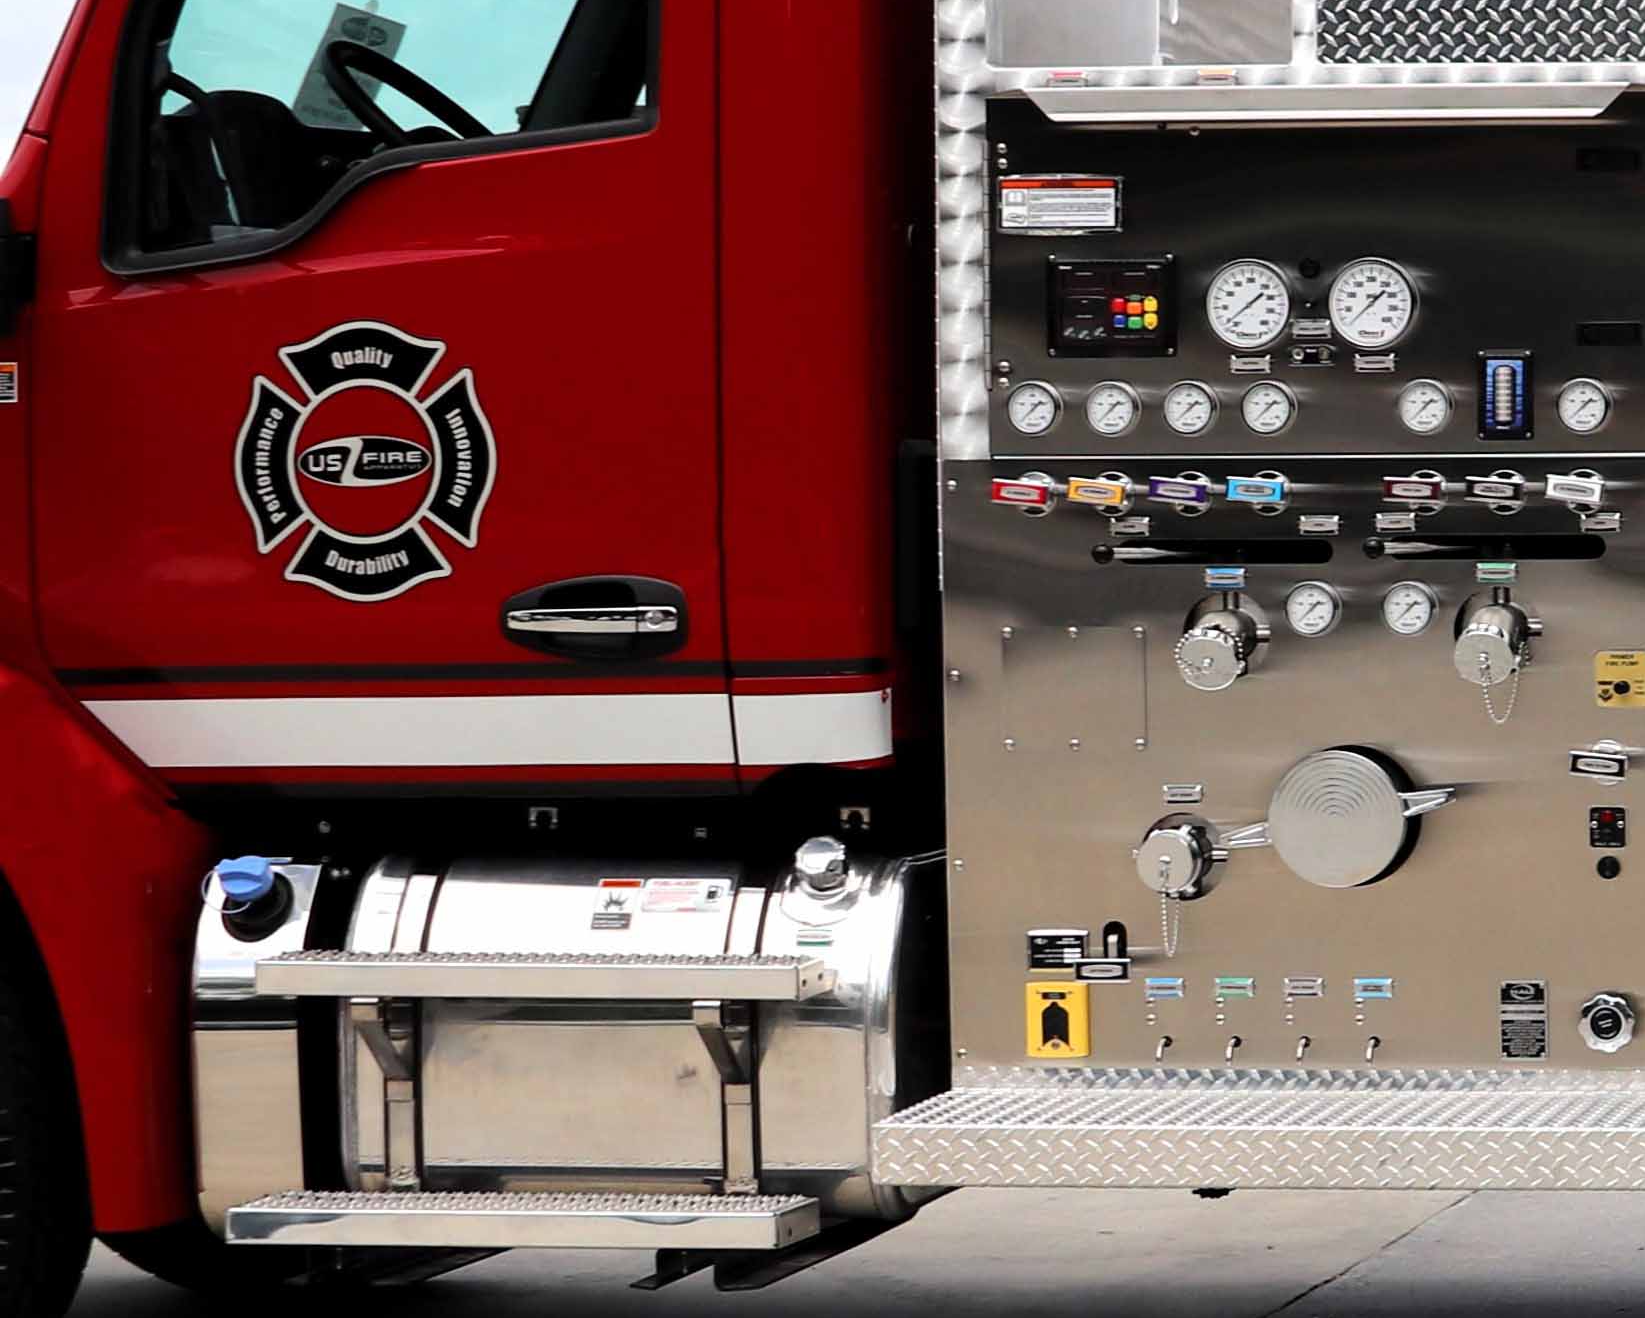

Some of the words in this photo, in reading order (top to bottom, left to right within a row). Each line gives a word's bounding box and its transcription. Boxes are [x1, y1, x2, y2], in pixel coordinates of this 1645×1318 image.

[331, 346, 394, 369] Quality
[255, 407, 287, 524] Performance
[308, 453, 342, 472] US
[362, 450, 422, 463] FIRE
[444, 407, 472, 507] Innovation
[325, 549, 409, 575] Durability
